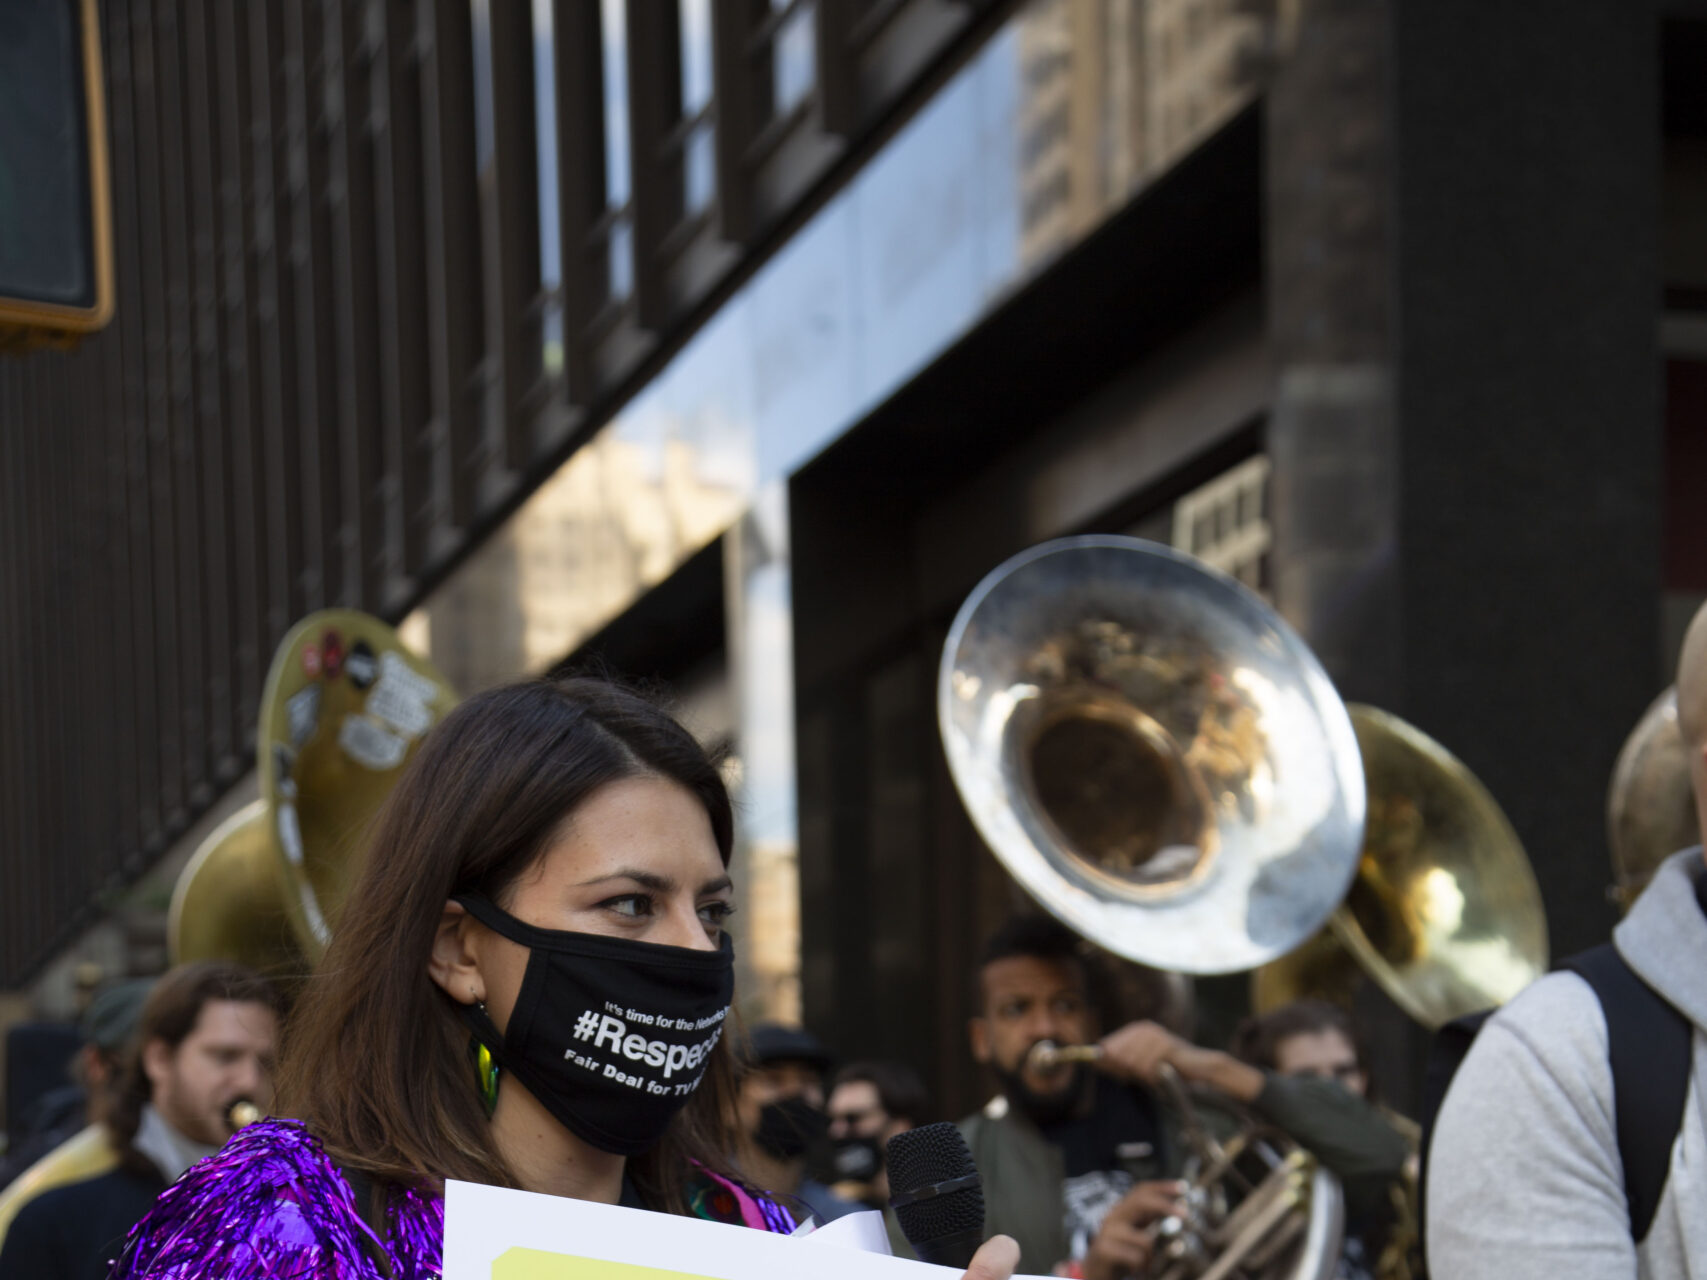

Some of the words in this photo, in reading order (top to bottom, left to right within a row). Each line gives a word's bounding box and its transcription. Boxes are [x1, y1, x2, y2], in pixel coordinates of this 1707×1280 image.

[604, 1001, 623, 1016] It's
[626, 1008, 654, 1025] time
[656, 1015, 675, 1029] for
[675, 1018, 694, 1031] the
[573, 1010, 722, 1078] #Respec
[564, 1049, 600, 1071] Fair
[602, 1064, 645, 1089] Deal
[647, 1080, 671, 1096] for
[674, 1082, 692, 1096] TV
